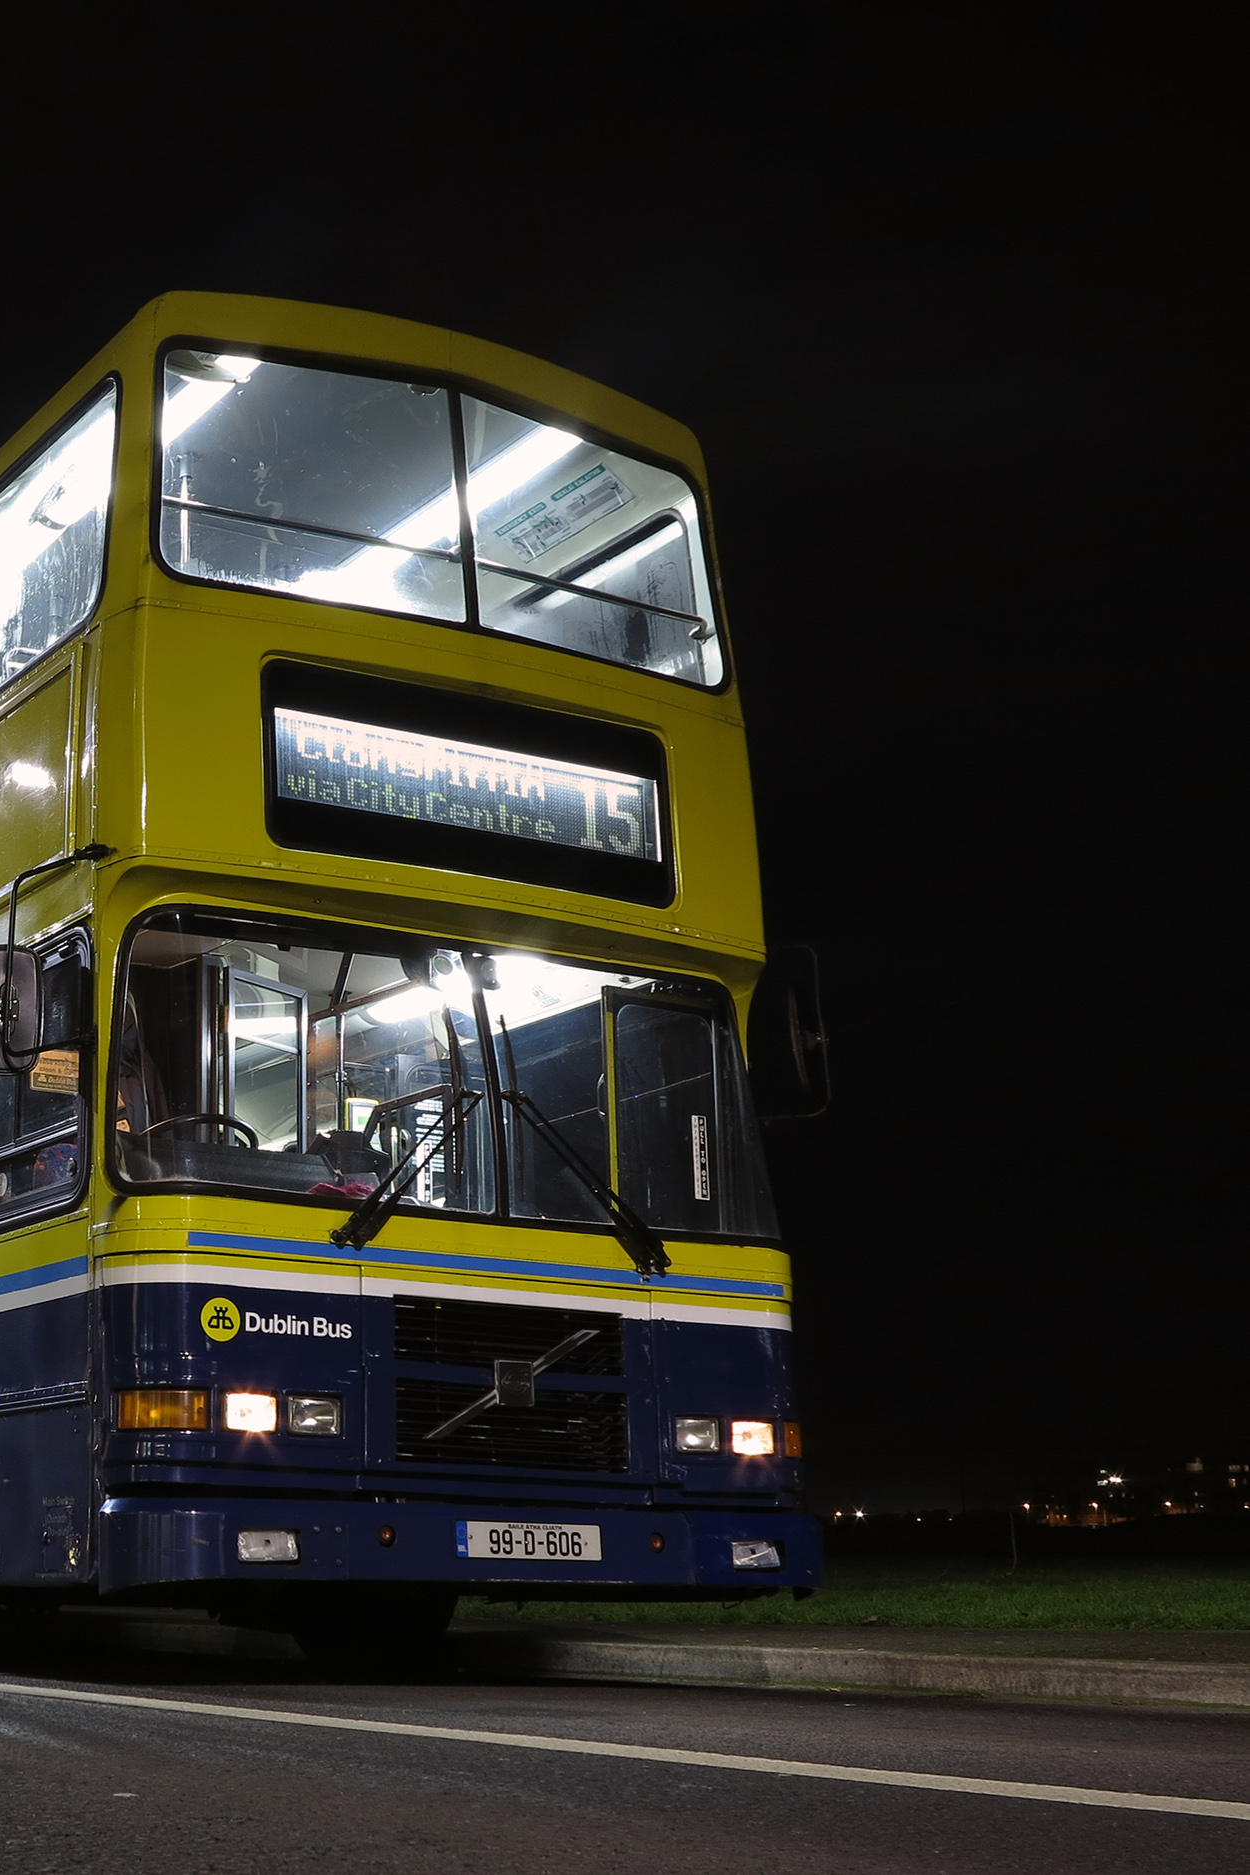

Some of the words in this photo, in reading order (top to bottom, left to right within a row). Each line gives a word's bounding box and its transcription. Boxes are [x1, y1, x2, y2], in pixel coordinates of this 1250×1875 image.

[573, 778, 644, 855] 15
[700, 1151, 706, 1164] TO
[244, 1311, 309, 1336] Dublin
[312, 1316, 352, 1339] Bus
[489, 1529, 582, 1557] 99-D-606
